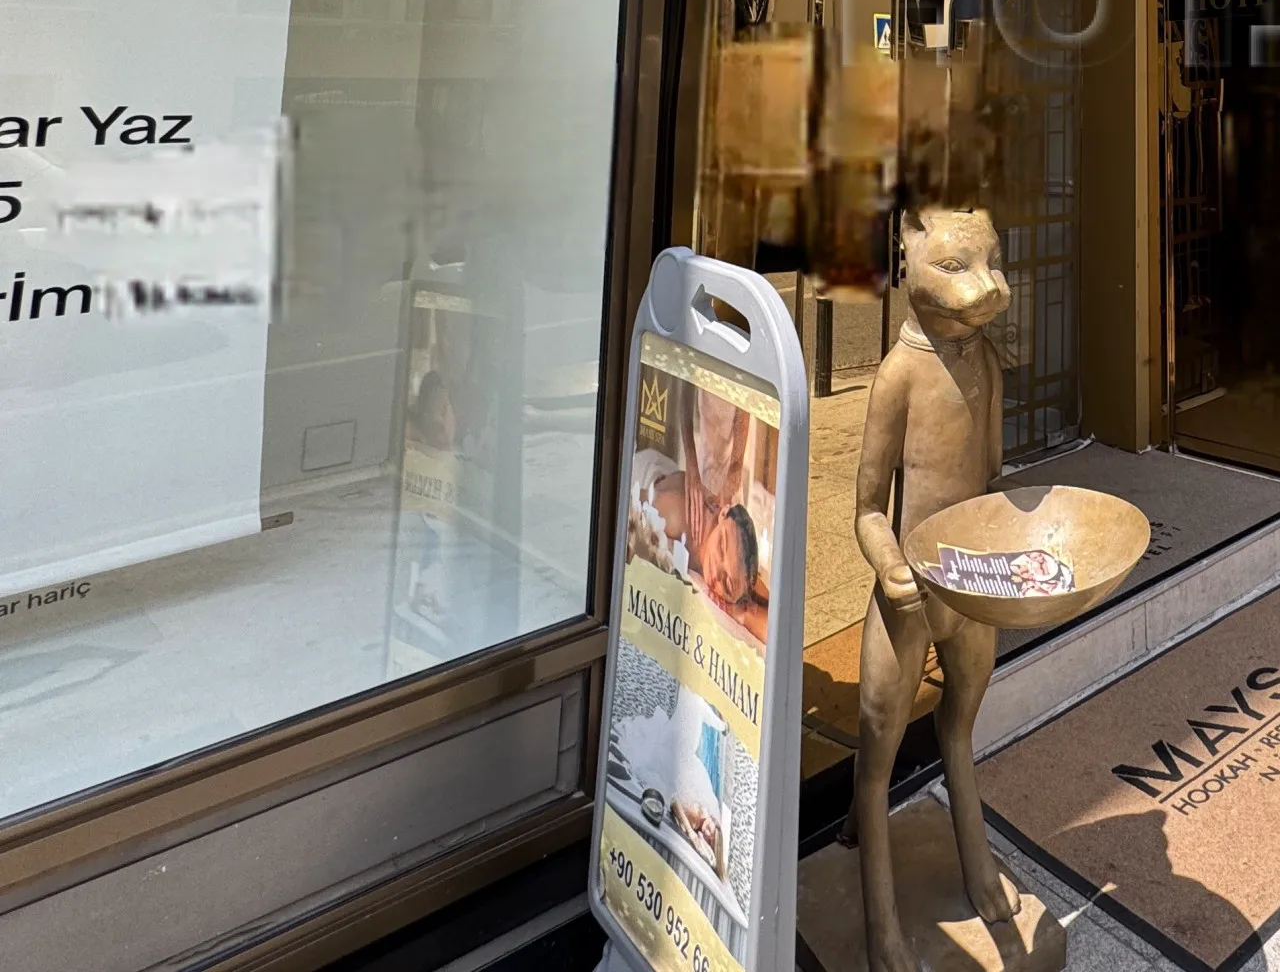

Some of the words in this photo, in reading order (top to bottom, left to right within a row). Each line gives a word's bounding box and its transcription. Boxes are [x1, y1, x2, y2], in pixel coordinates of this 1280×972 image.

[80, 105, 194, 146] Yaz
[28, 582, 91, 609] hariç
[627, 585, 691, 655] MASSAGE
[693, 634, 704, 669] &
[708, 645, 760, 726] HAMAM
[1171, 752, 1258, 815] HOOKAH
[609, 848, 633, 888] +90
[636, 872, 663, 921] 530
[665, 905, 690, 960] 952
